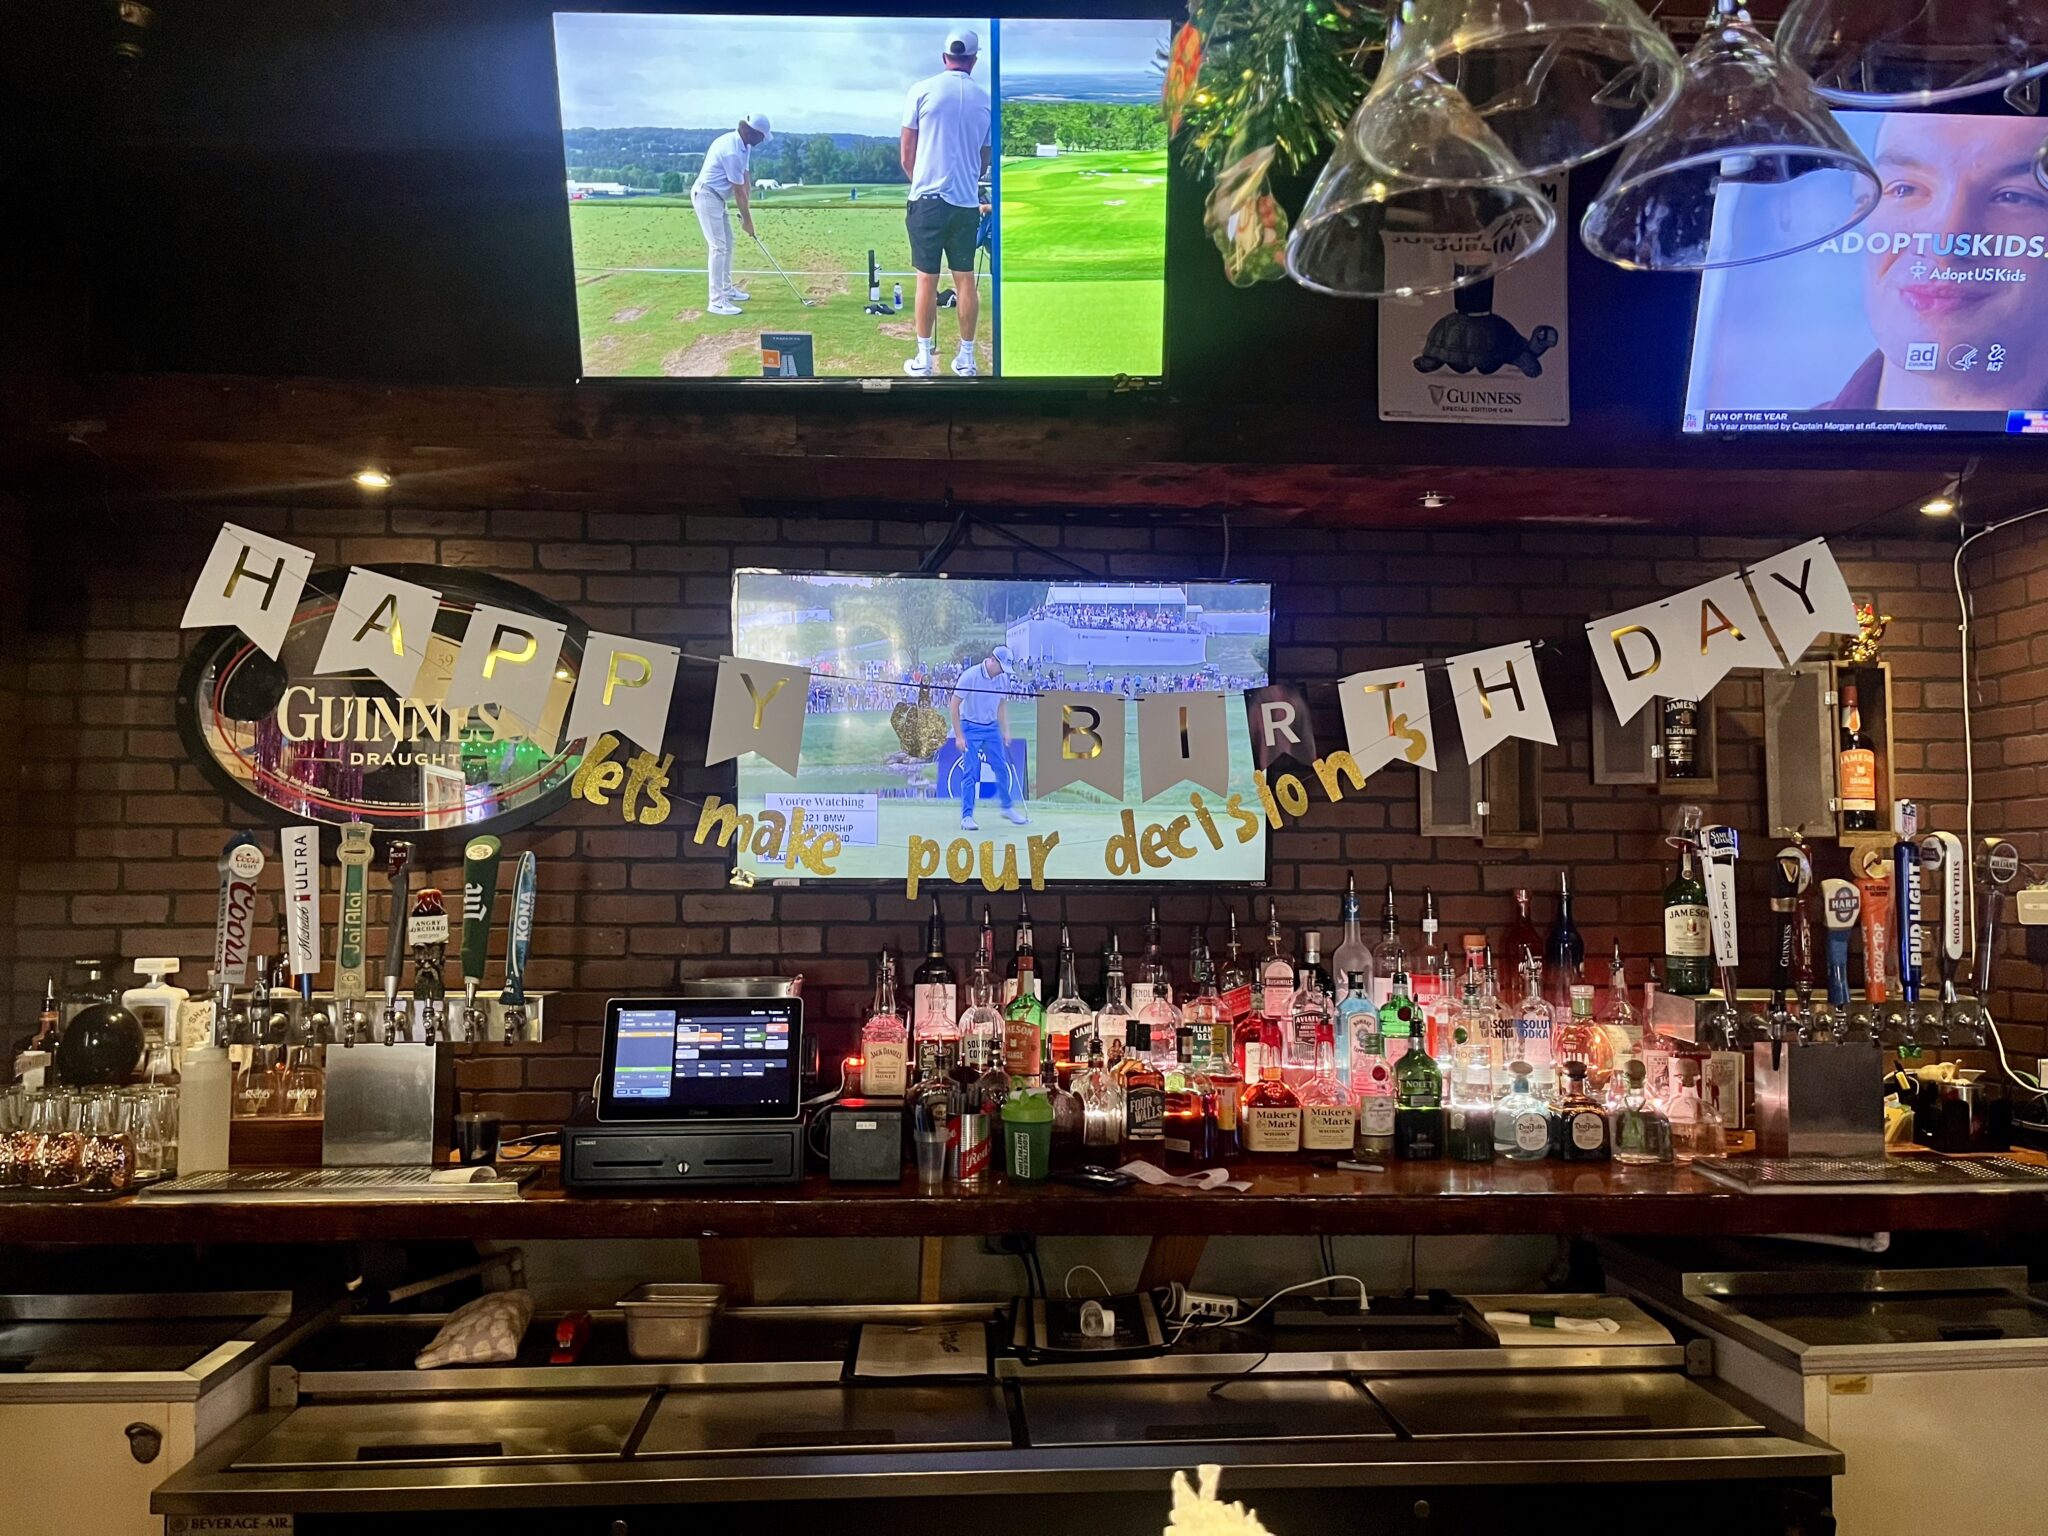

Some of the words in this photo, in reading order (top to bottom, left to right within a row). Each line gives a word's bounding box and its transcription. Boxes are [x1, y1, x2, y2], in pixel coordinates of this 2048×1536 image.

[1929, 268, 2027, 283] AdoptUSKids
[1910, 346, 1935, 361] ad
[1986, 362, 2004, 372] ACF
[1447, 389, 1522, 405] GUINNESS
[1710, 413, 1728, 421] FAN
[1730, 413, 1743, 421] OF
[1744, 413, 1762, 421] THE
[1763, 413, 1788, 421] YEAR
[1706, 423, 1719, 431] the
[1721, 423, 1738, 431] Year
[1740, 423, 1779, 432] presented
[1780, 423, 1790, 432] by
[1792, 423, 1823, 432] Captain
[1824, 423, 1854, 432] Morgan
[351, 752, 462, 766] DRAUGHT
[694, 795, 841, 876] make
[906, 831, 1059, 900] pour
[1107, 712, 1427, 875] decisions
[779, 797, 812, 807] You're
[814, 797, 865, 809] Watching
[823, 813, 846, 822] BMW
[789, 824, 854, 833] AMPIONSHIP
[294, 835, 309, 890] ULTRA
[1908, 862, 1922, 923] LIGHT
[1831, 898, 1858, 909] HARP
[516, 891, 532, 941] KONA
[1720, 880, 1734, 959] SEASONAL
[299, 906, 312, 960] Michelob
[1952, 908, 1960, 945] ARTOIS
[343, 928, 361, 954] Jai
[1779, 924, 1793, 968] GUINNESS
[1909, 926, 1922, 967] BUD
[1132, 987, 1153, 995] PENDL
[1186, 1025, 1213, 1033] TULLAM
[1130, 1096, 1154, 1113] FOUR
[1134, 1105, 1162, 1123] WALLS
[1256, 1110, 1298, 1119] Maker's
[1311, 1108, 1353, 1117] Maker's
[1267, 1120, 1297, 1128] Mark
[1322, 1117, 1352, 1126] Mark
[191, 1518, 290, 1530] BEVERAGE-AIR
